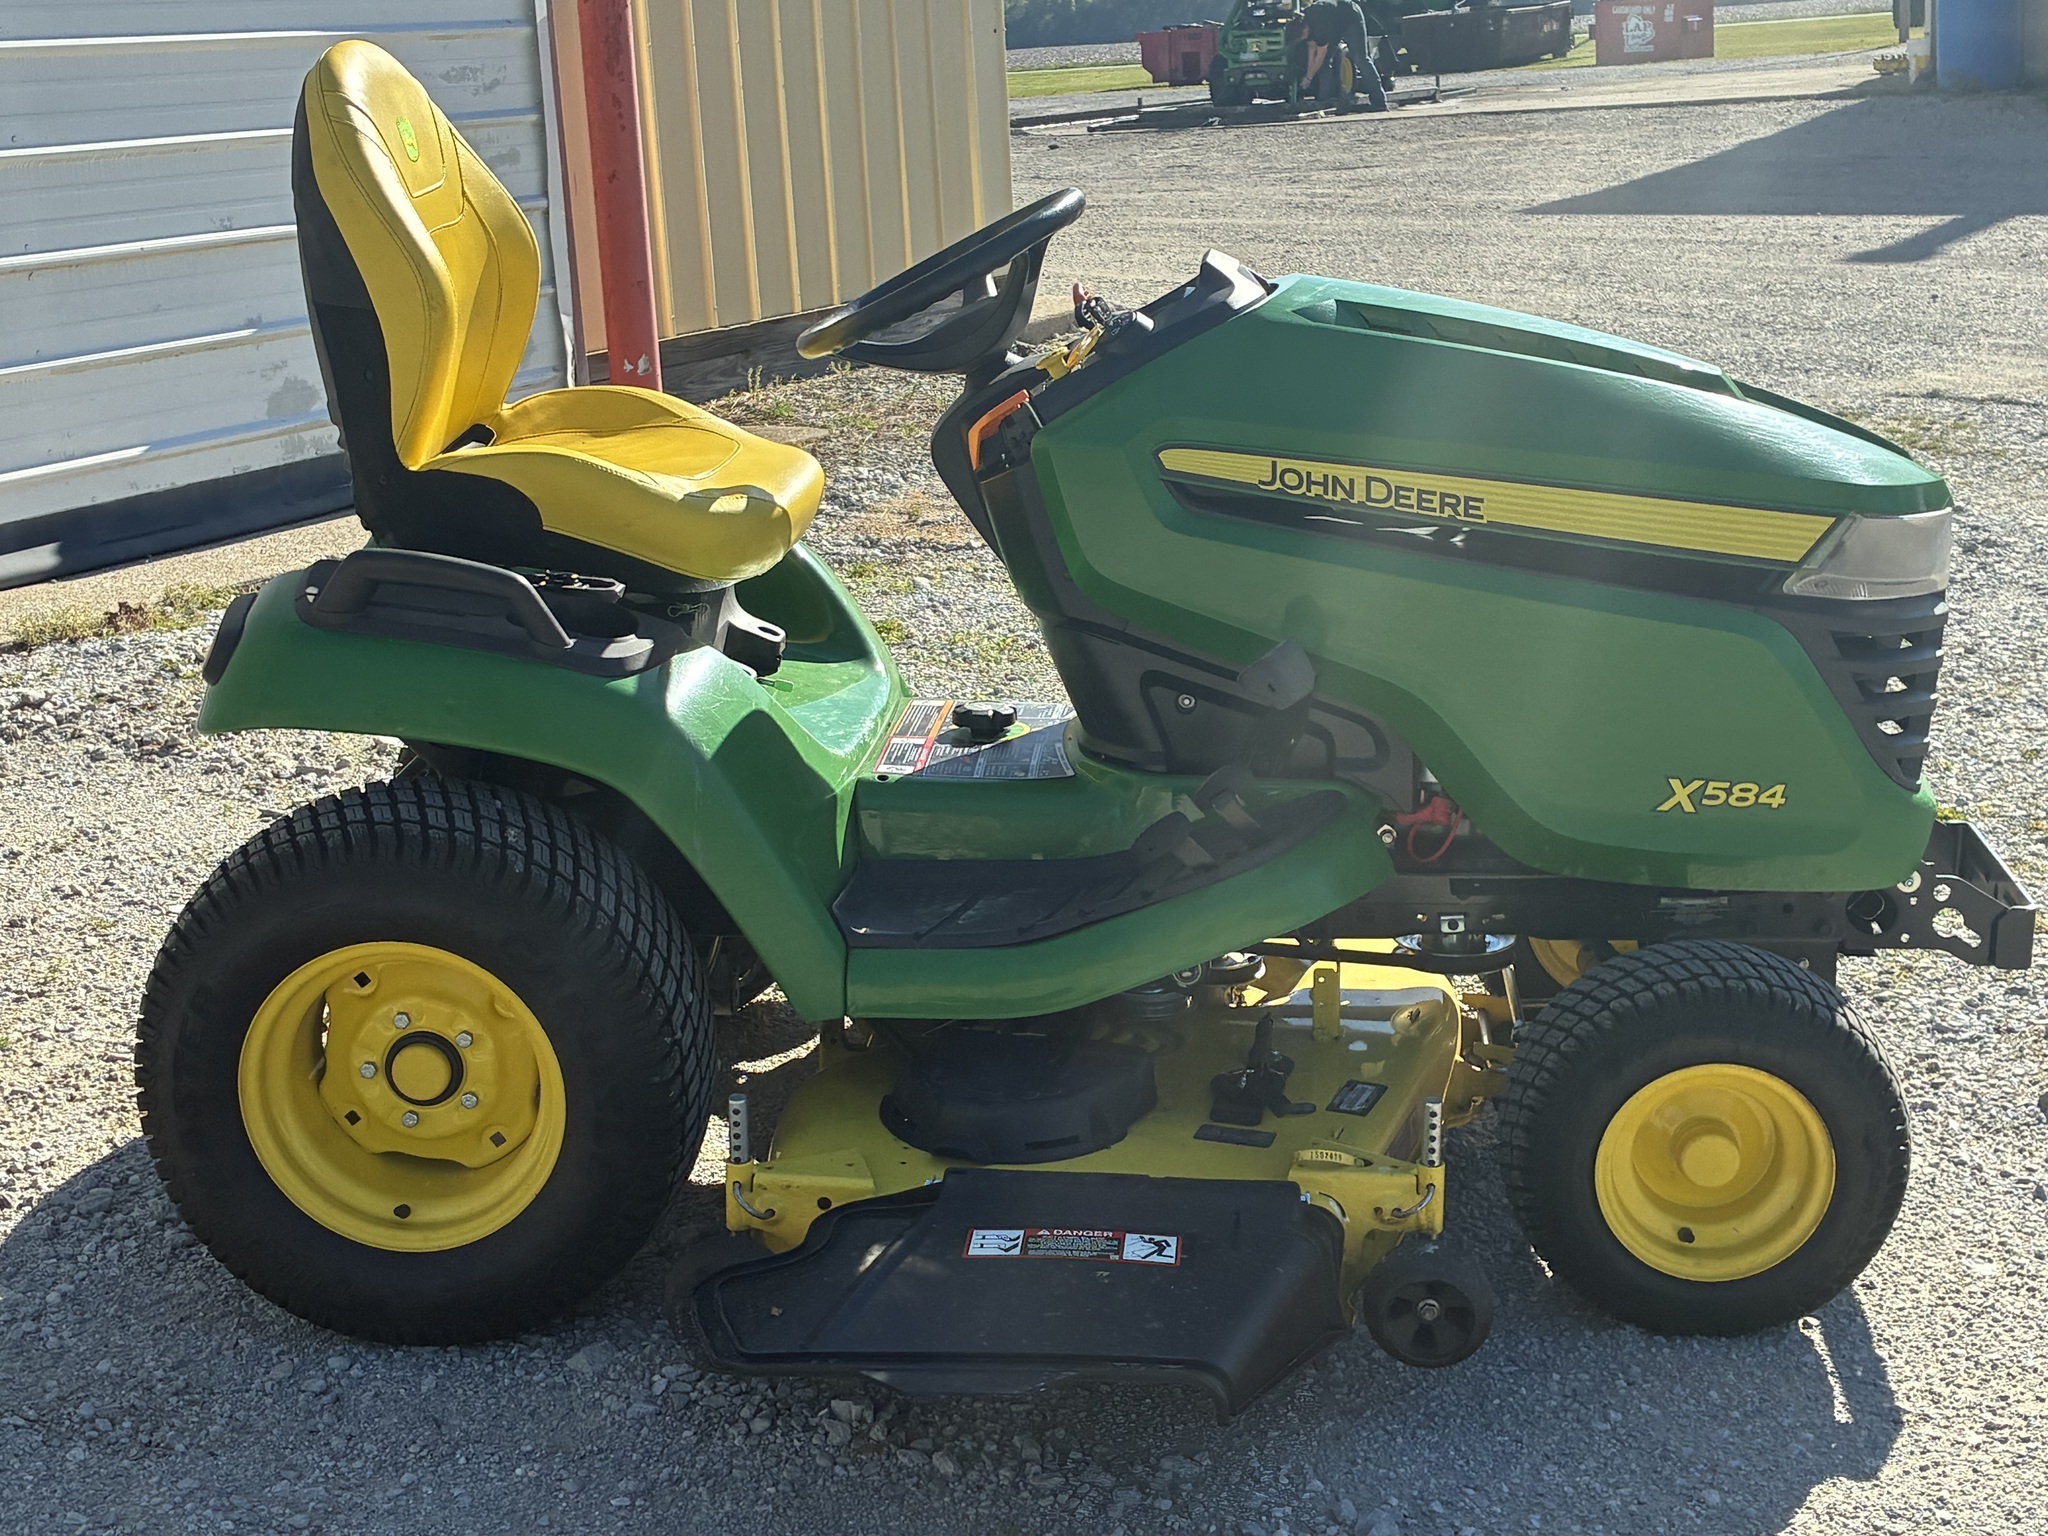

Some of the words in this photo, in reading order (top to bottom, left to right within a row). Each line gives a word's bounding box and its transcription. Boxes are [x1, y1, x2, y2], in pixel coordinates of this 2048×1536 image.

[1258, 460, 1355, 500] JOHN
[1365, 475, 1485, 520] DEERE
[1655, 778, 1787, 813] X584
[1053, 1229, 1113, 1237] DANGER
